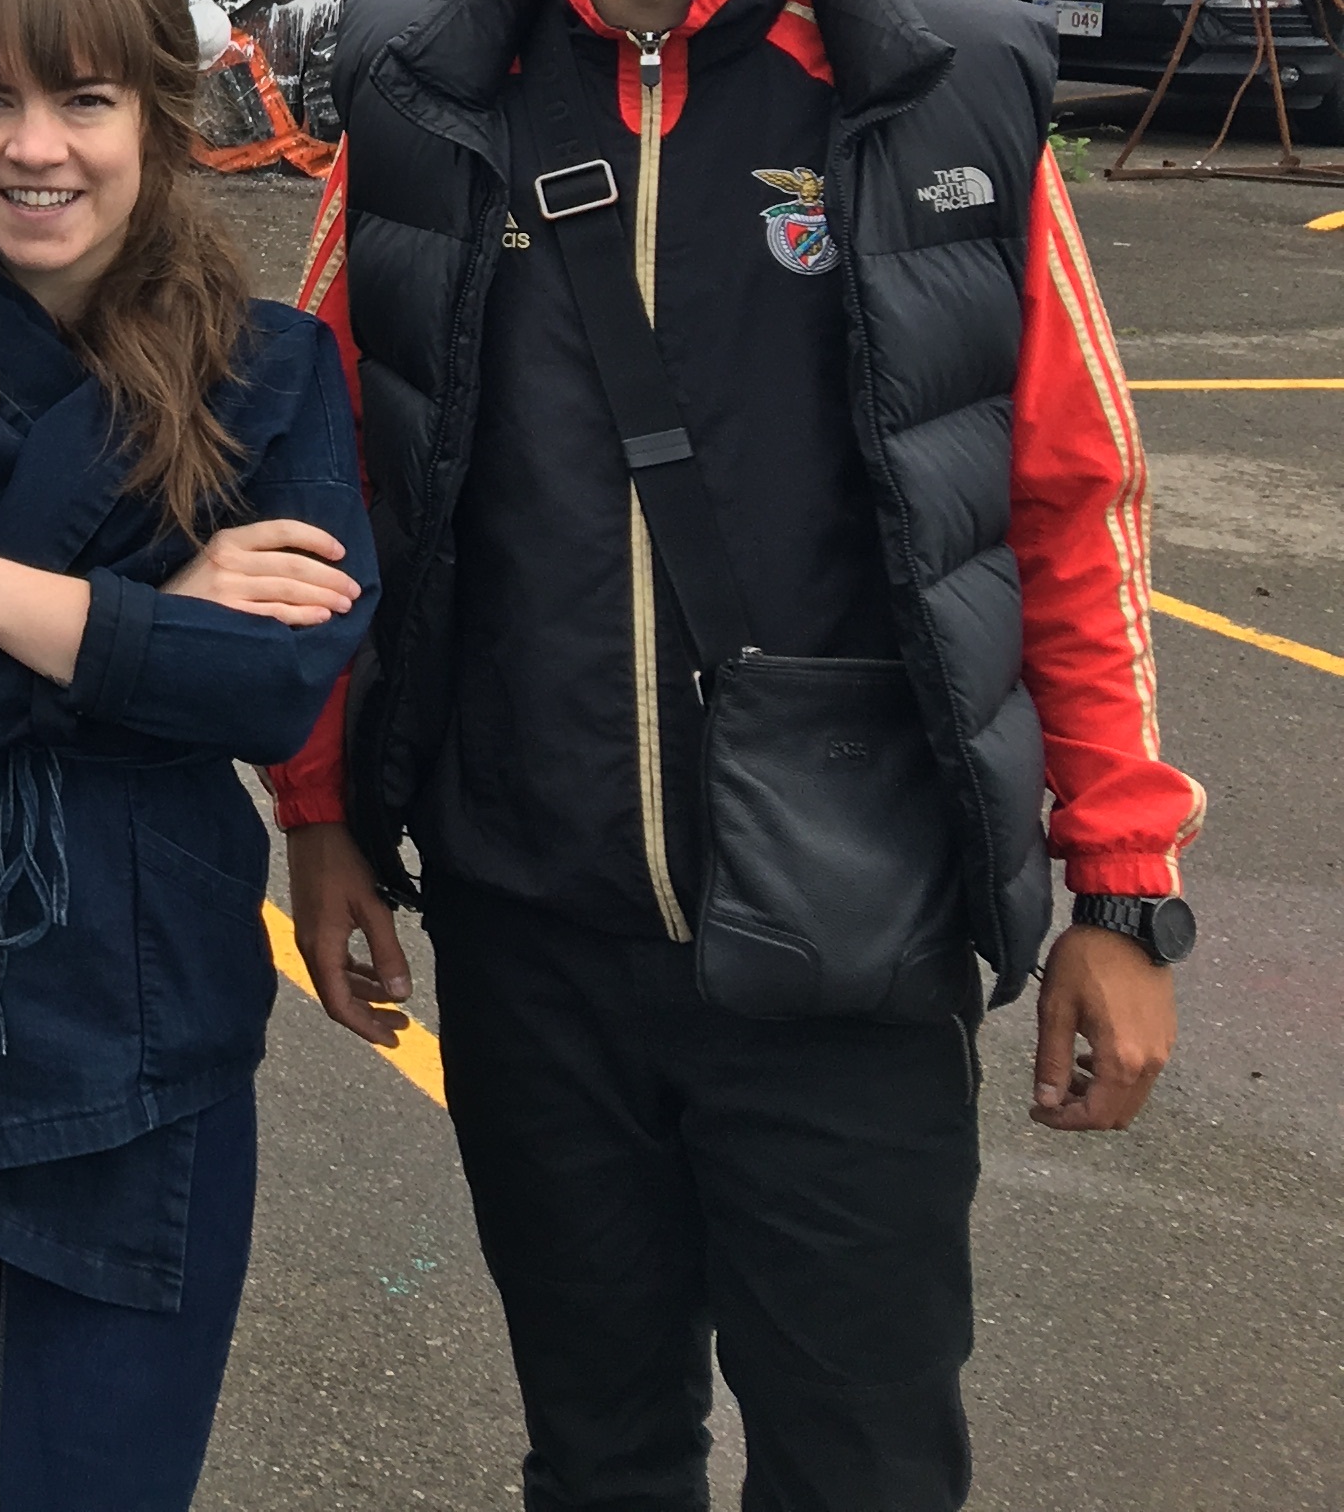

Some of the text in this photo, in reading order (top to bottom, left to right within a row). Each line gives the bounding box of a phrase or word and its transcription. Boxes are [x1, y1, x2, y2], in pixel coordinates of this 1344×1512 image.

[1072, 12, 1098, 29] 049
[934, 169, 964, 183] THE
[917, 183, 967, 201] NORTH
[934, 195, 969, 213] FACE
